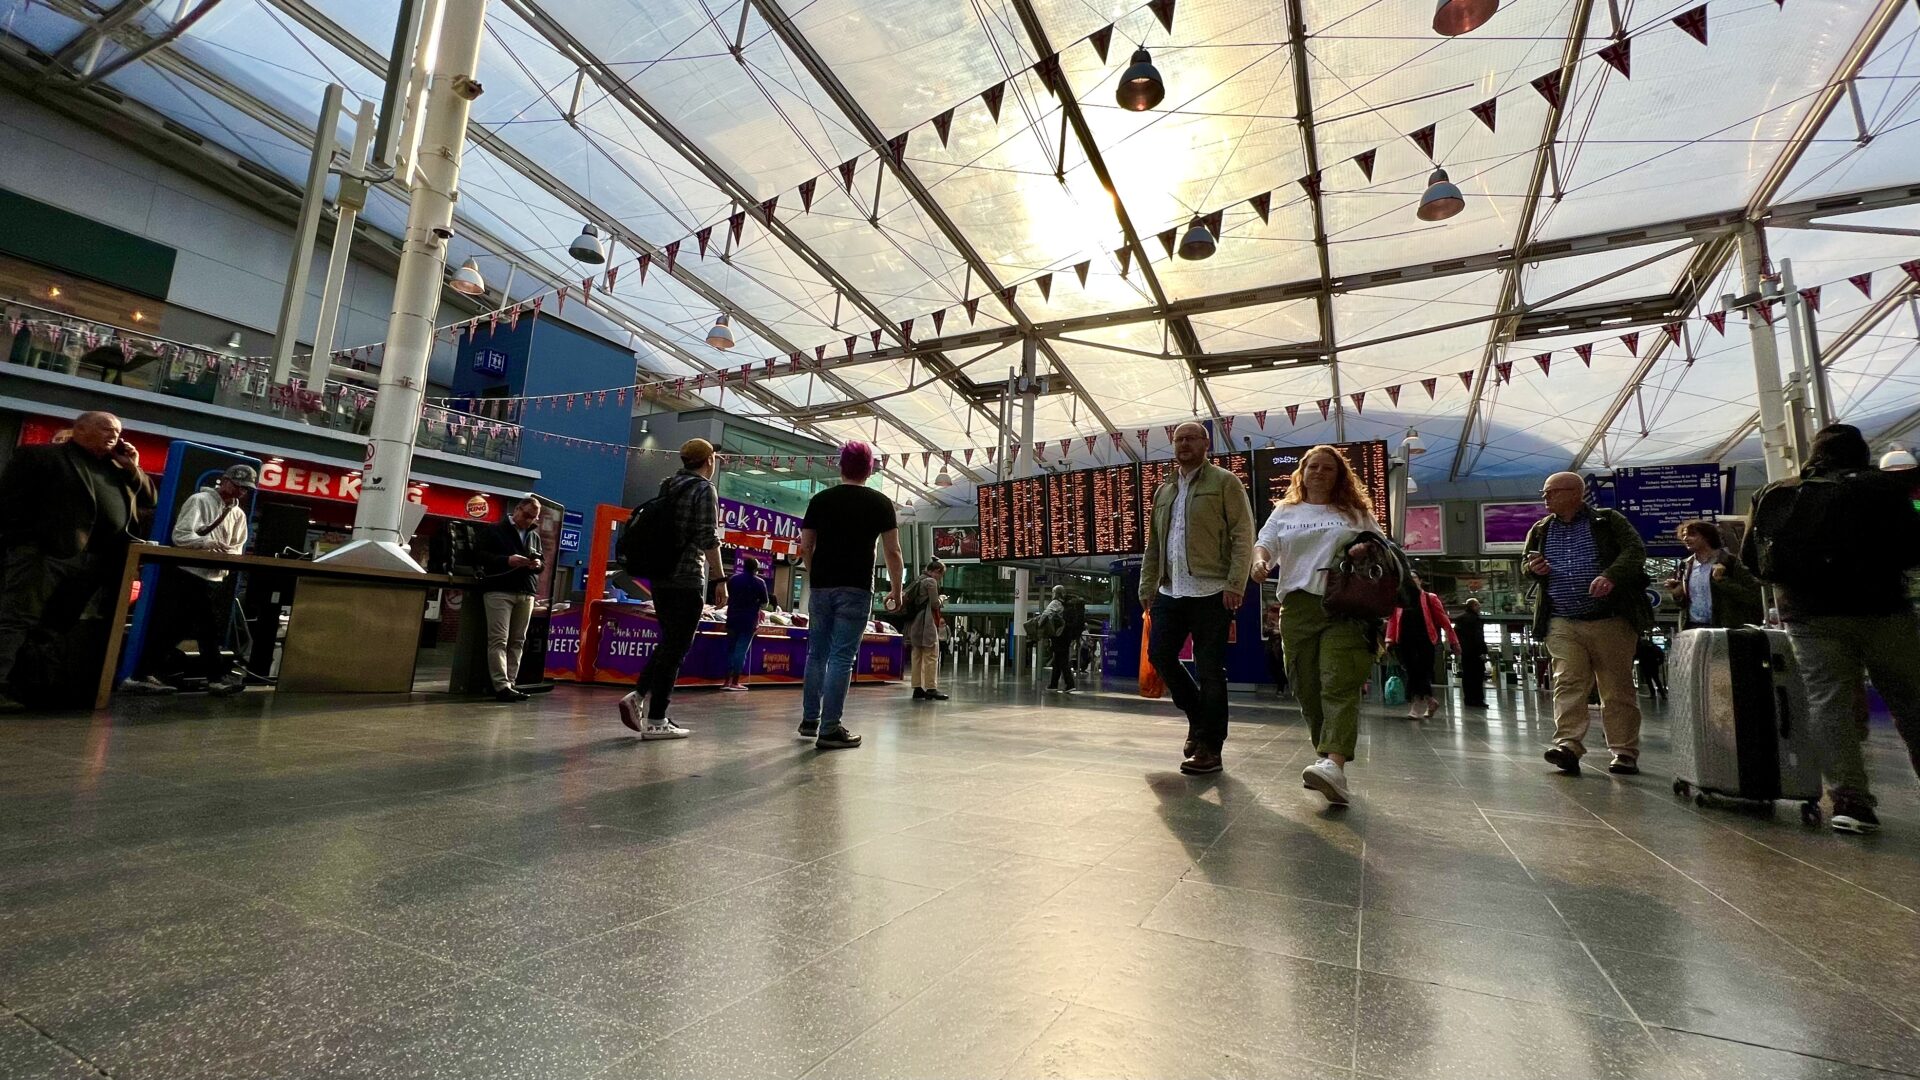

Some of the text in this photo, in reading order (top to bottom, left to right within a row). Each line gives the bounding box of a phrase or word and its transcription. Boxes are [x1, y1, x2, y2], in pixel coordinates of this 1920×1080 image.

[259, 463, 423, 505] GER KG
[718, 503, 751, 530] ick
[774, 515, 802, 539] Mix
[563, 532, 578, 540] LIFT
[561, 539, 578, 547] ONLY
[641, 628, 658, 638] Mix
[547, 638, 581, 654] WEETS
